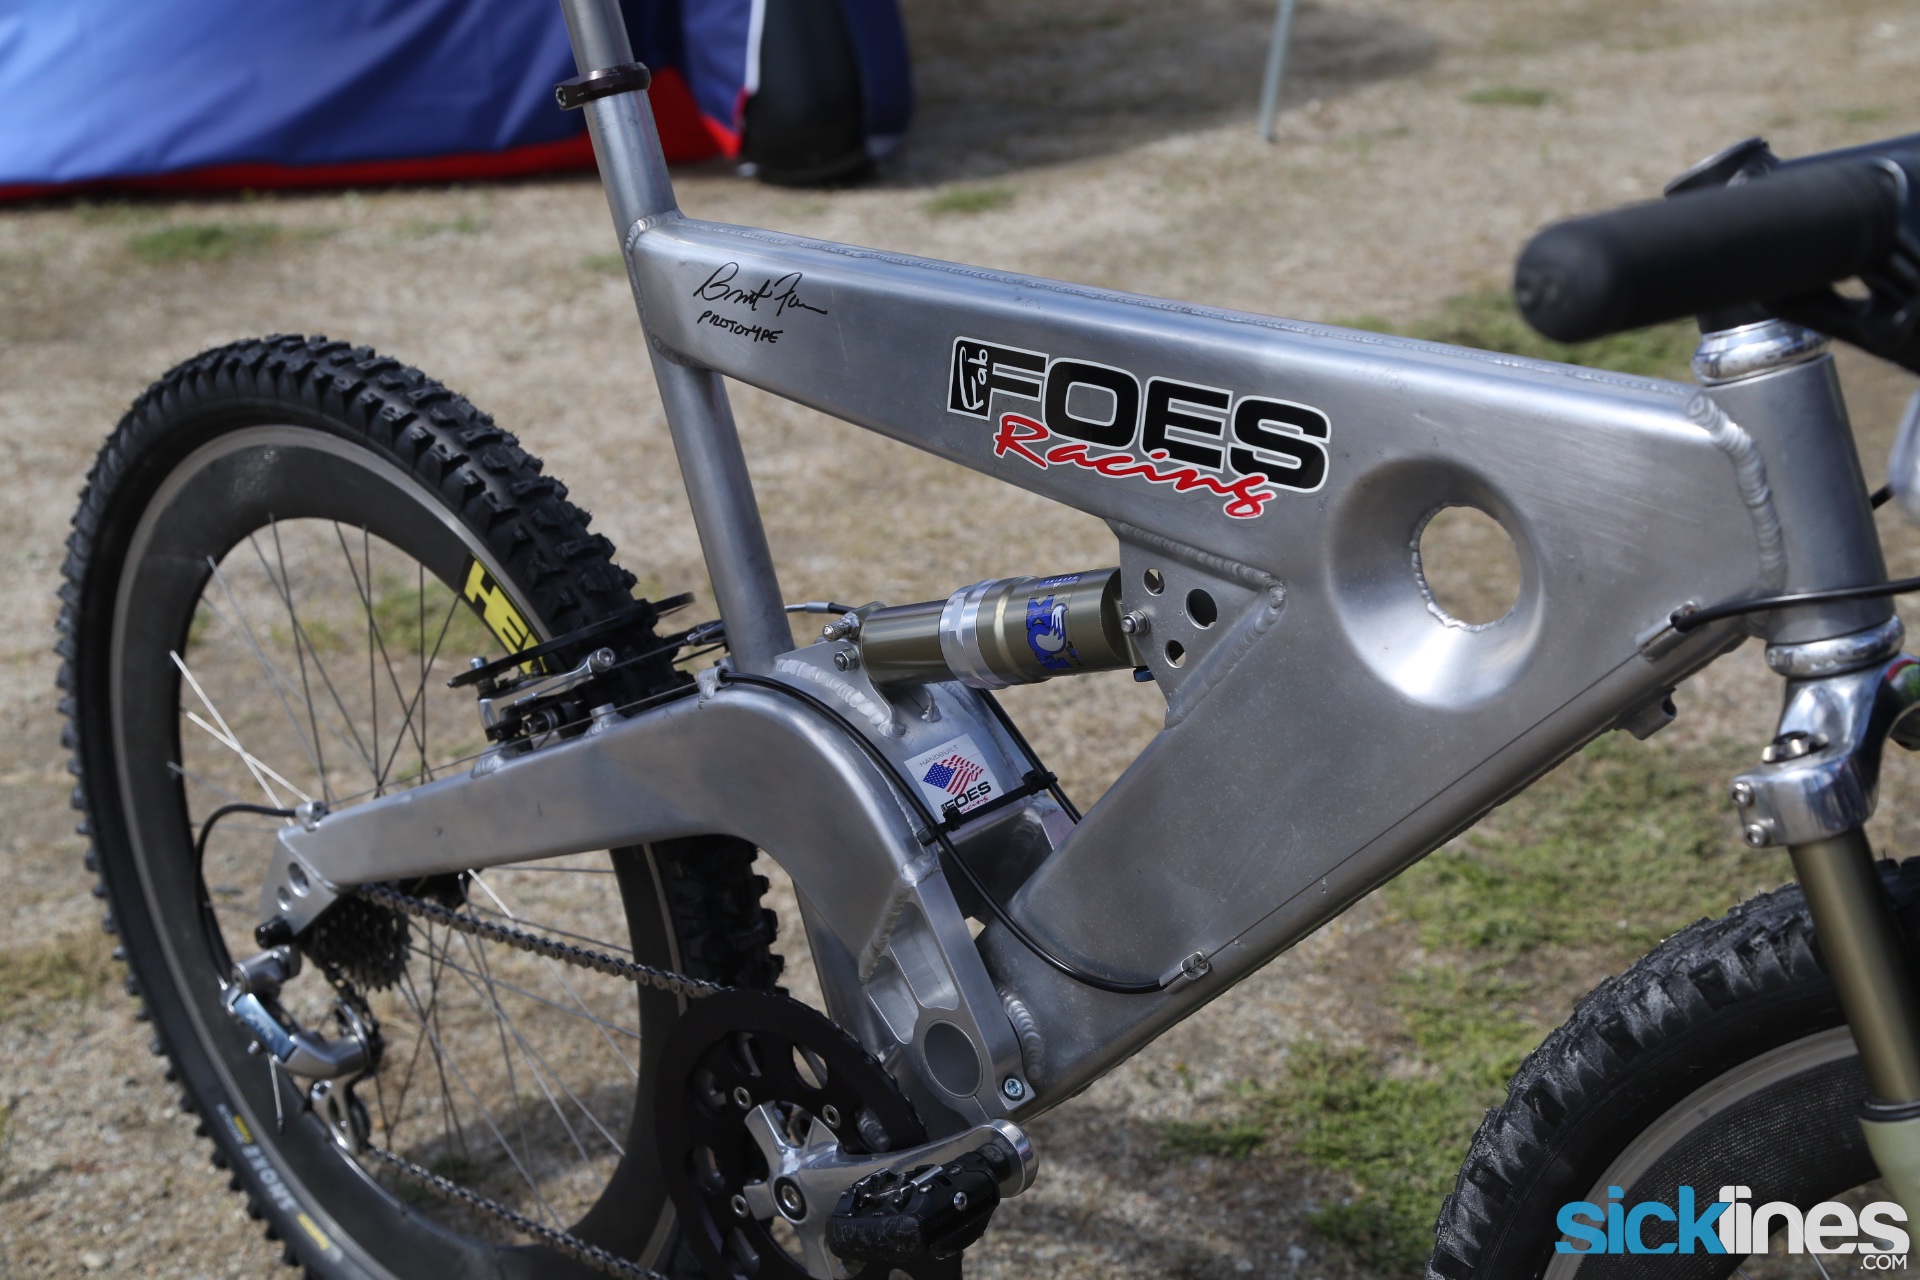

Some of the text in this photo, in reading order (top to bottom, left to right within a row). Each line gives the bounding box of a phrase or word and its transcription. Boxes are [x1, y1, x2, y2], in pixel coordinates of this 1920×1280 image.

[696, 310, 784, 344] PROTOTYPE
[948, 336, 1331, 493] FOES
[994, 413, 1277, 518] Racing
[1026, 594, 1074, 671] FOX
[919, 744, 958, 767] HANDBUILT
